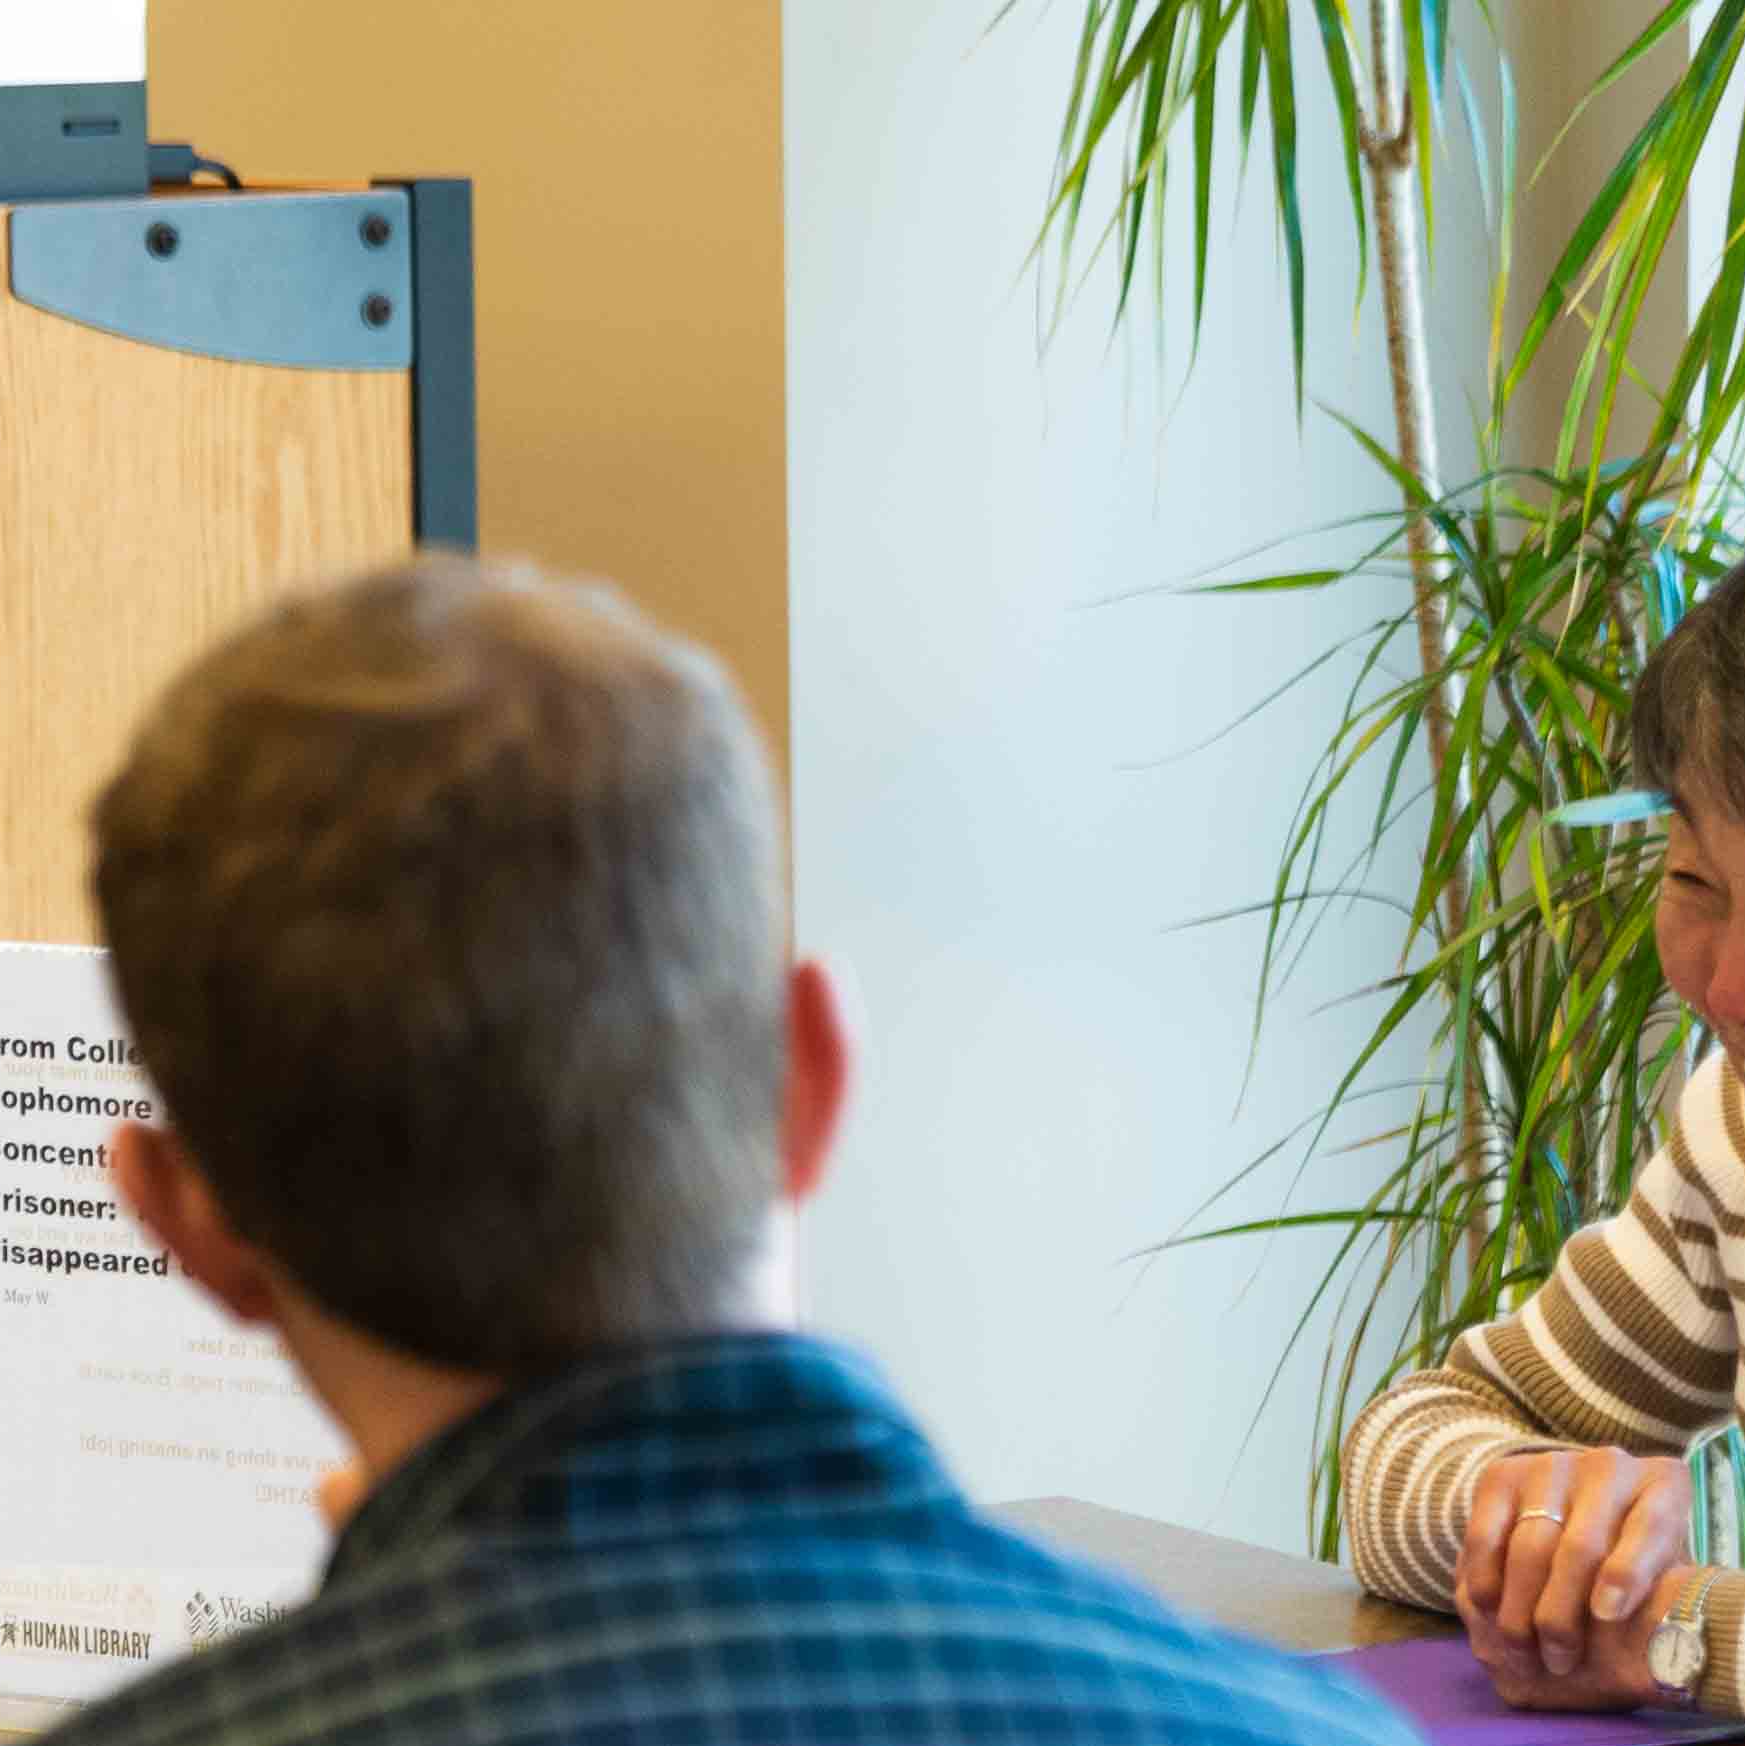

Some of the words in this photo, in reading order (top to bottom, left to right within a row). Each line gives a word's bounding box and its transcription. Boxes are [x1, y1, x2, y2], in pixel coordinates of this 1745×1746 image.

[67, 1036, 144, 1065] Colle
[4, 1288, 32, 1306] May
[23, 1620, 79, 1653] HUMAN
[84, 1626, 151, 1660] LIBRARY
